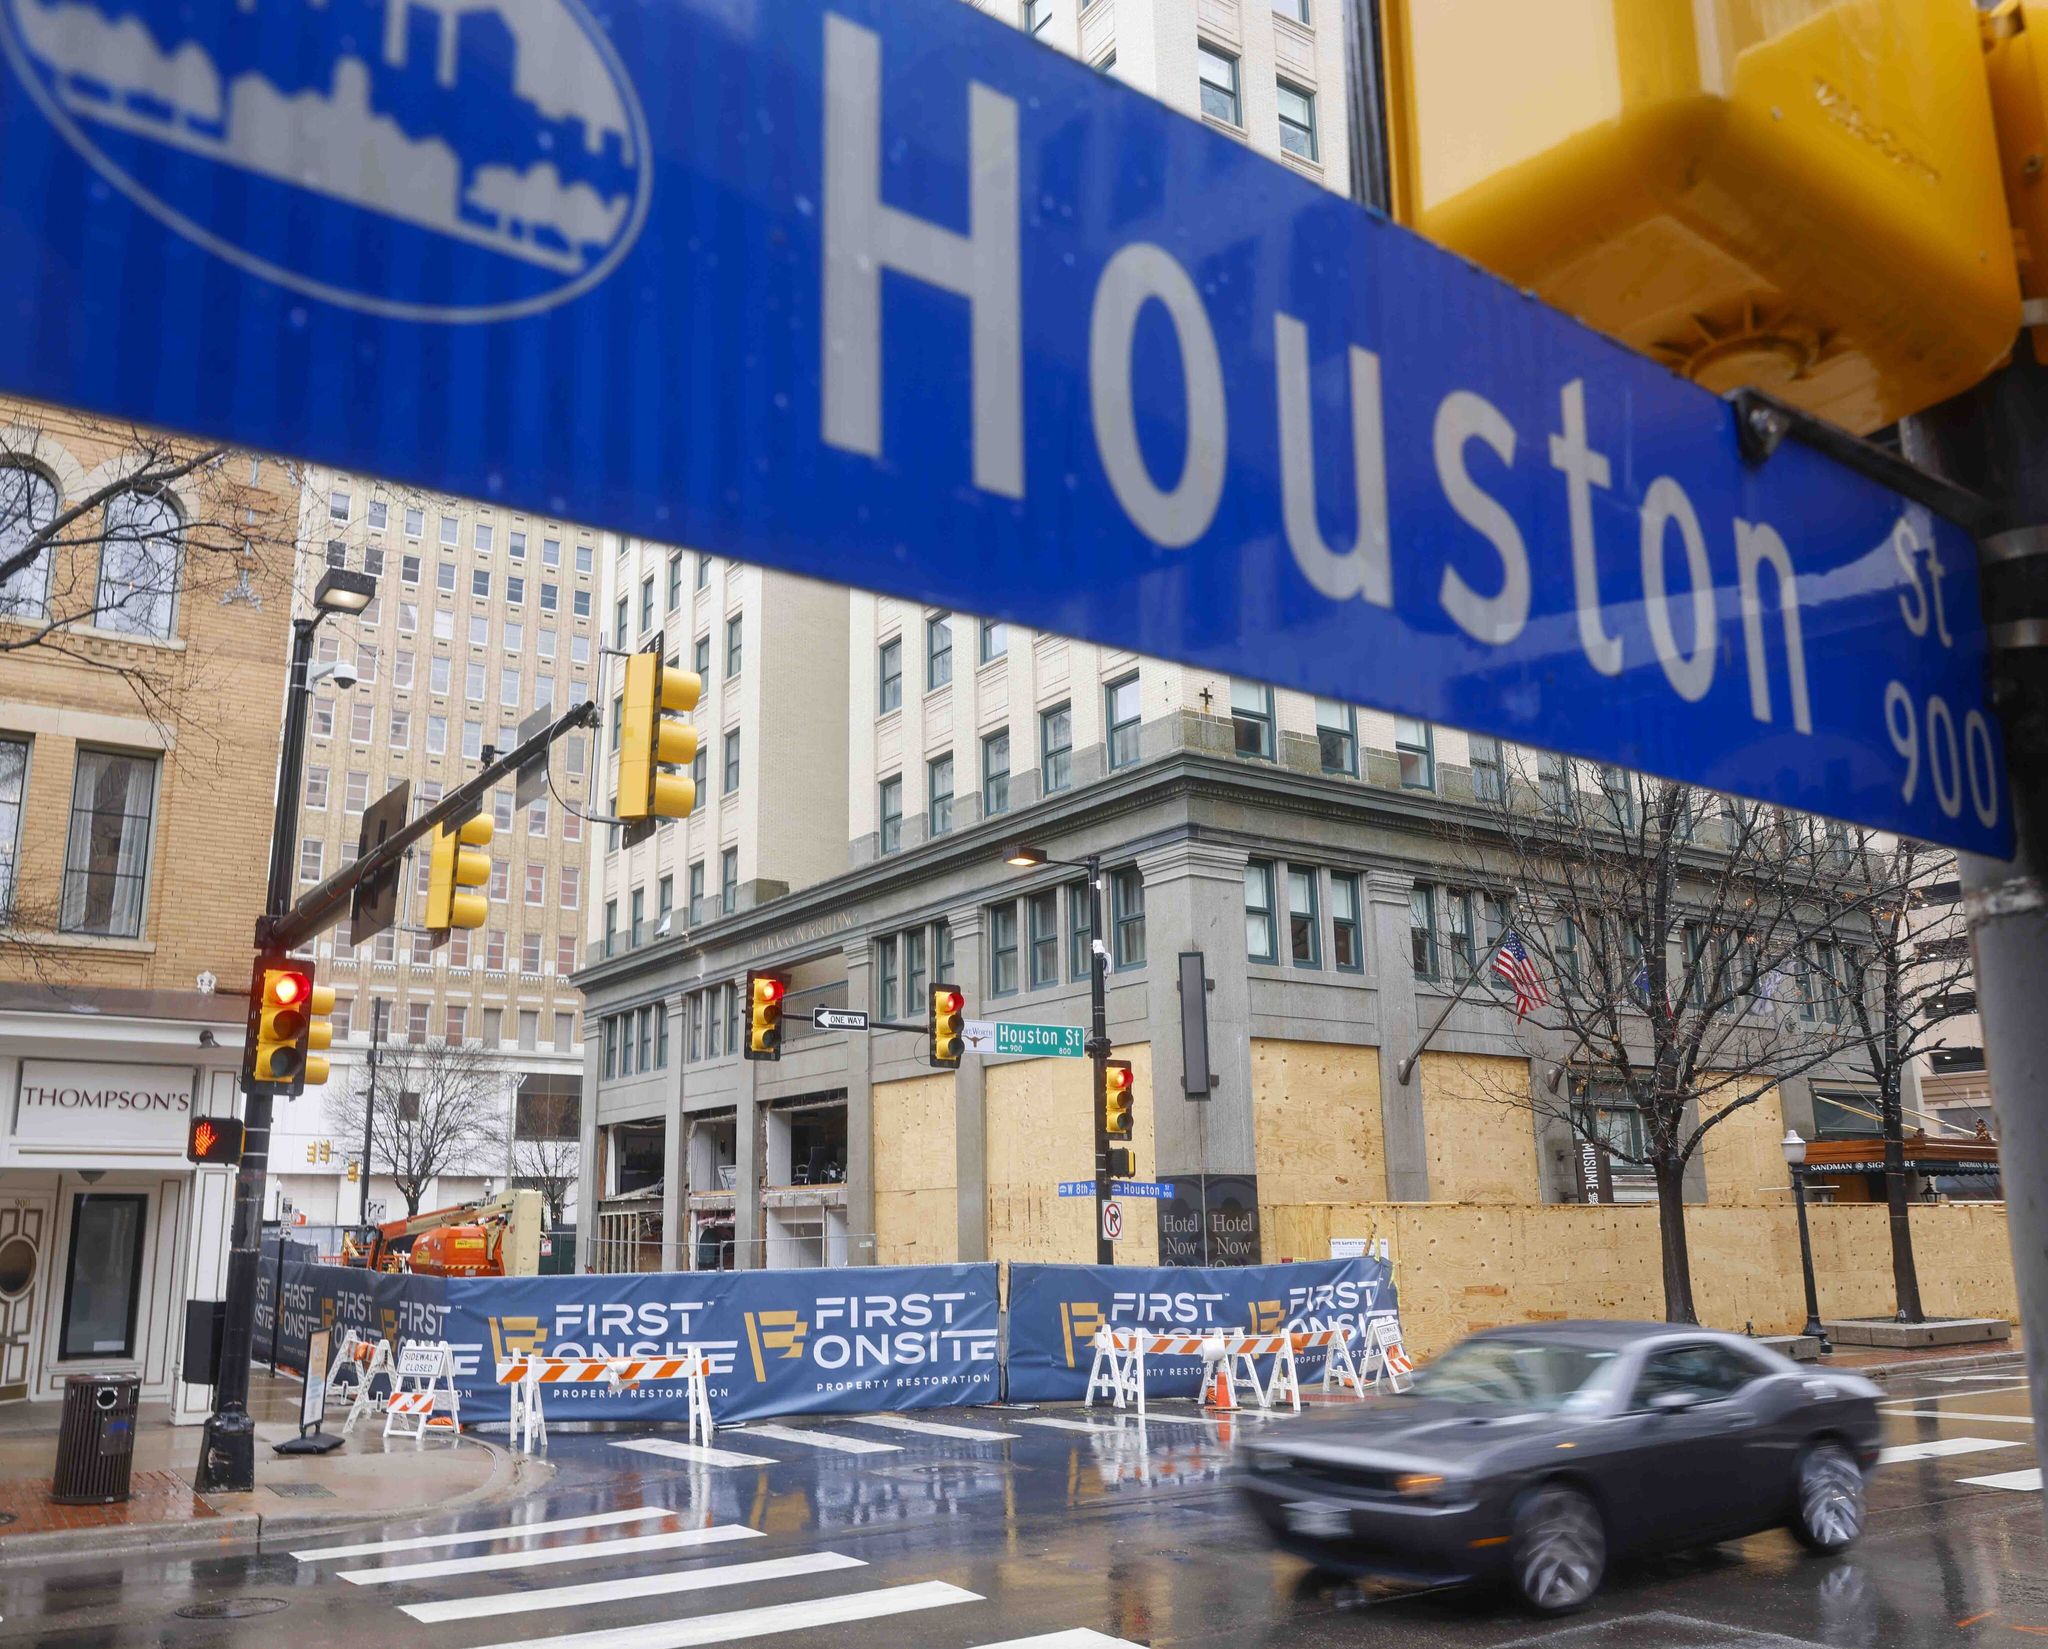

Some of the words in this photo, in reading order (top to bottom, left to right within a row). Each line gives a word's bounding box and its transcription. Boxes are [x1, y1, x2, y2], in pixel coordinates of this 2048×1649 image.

[821, 12, 1812, 736] Houston
[1893, 515, 1953, 649] St
[1884, 680, 1999, 829] 900
[830, 1015, 845, 1024] ONE
[847, 1016, 863, 1025] WAY
[1000, 1024, 1058, 1046] Houston
[1065, 1028, 1080, 1047] St
[1009, 1044, 1023, 1053] 900
[1058, 1047, 1072, 1056] 800
[23, 1086, 190, 1112] THOMPSON'S
[1581, 1142, 1599, 1190] MUSUME
[1810, 1162, 1852, 1172] SANDMAN
[1866, 1160, 1916, 1170] SIGNRE
[1067, 1184, 1074, 1195] W
[1076, 1183, 1088, 1195] 8th
[1123, 1184, 1160, 1196] Houston
[1164, 1183, 1170, 1191] St
[1163, 1190, 1173, 1199] 900
[1163, 1213, 1199, 1233] Hotel
[1212, 1213, 1254, 1232] Hotel
[1166, 1236, 1197, 1255] Now
[1216, 1236, 1251, 1255] Now
[283, 1282, 315, 1311] FIRST
[336, 1290, 373, 1323] FIRST
[1288, 1280, 1378, 1315] FIRST
[815, 1292, 966, 1330] FIRST
[1111, 1292, 1223, 1323] FIRST
[398, 1300, 452, 1337] FIRST
[555, 1301, 704, 1337] FIRST
[404, 1352, 439, 1362] SIDEWALK
[812, 1328, 999, 1370] ONSITE
[405, 1363, 433, 1373] CLOSED
[816, 1378, 889, 1392] PROPERTY
[896, 1373, 991, 1387] RESTORATION
[553, 1388, 623, 1399] PROPERTY
